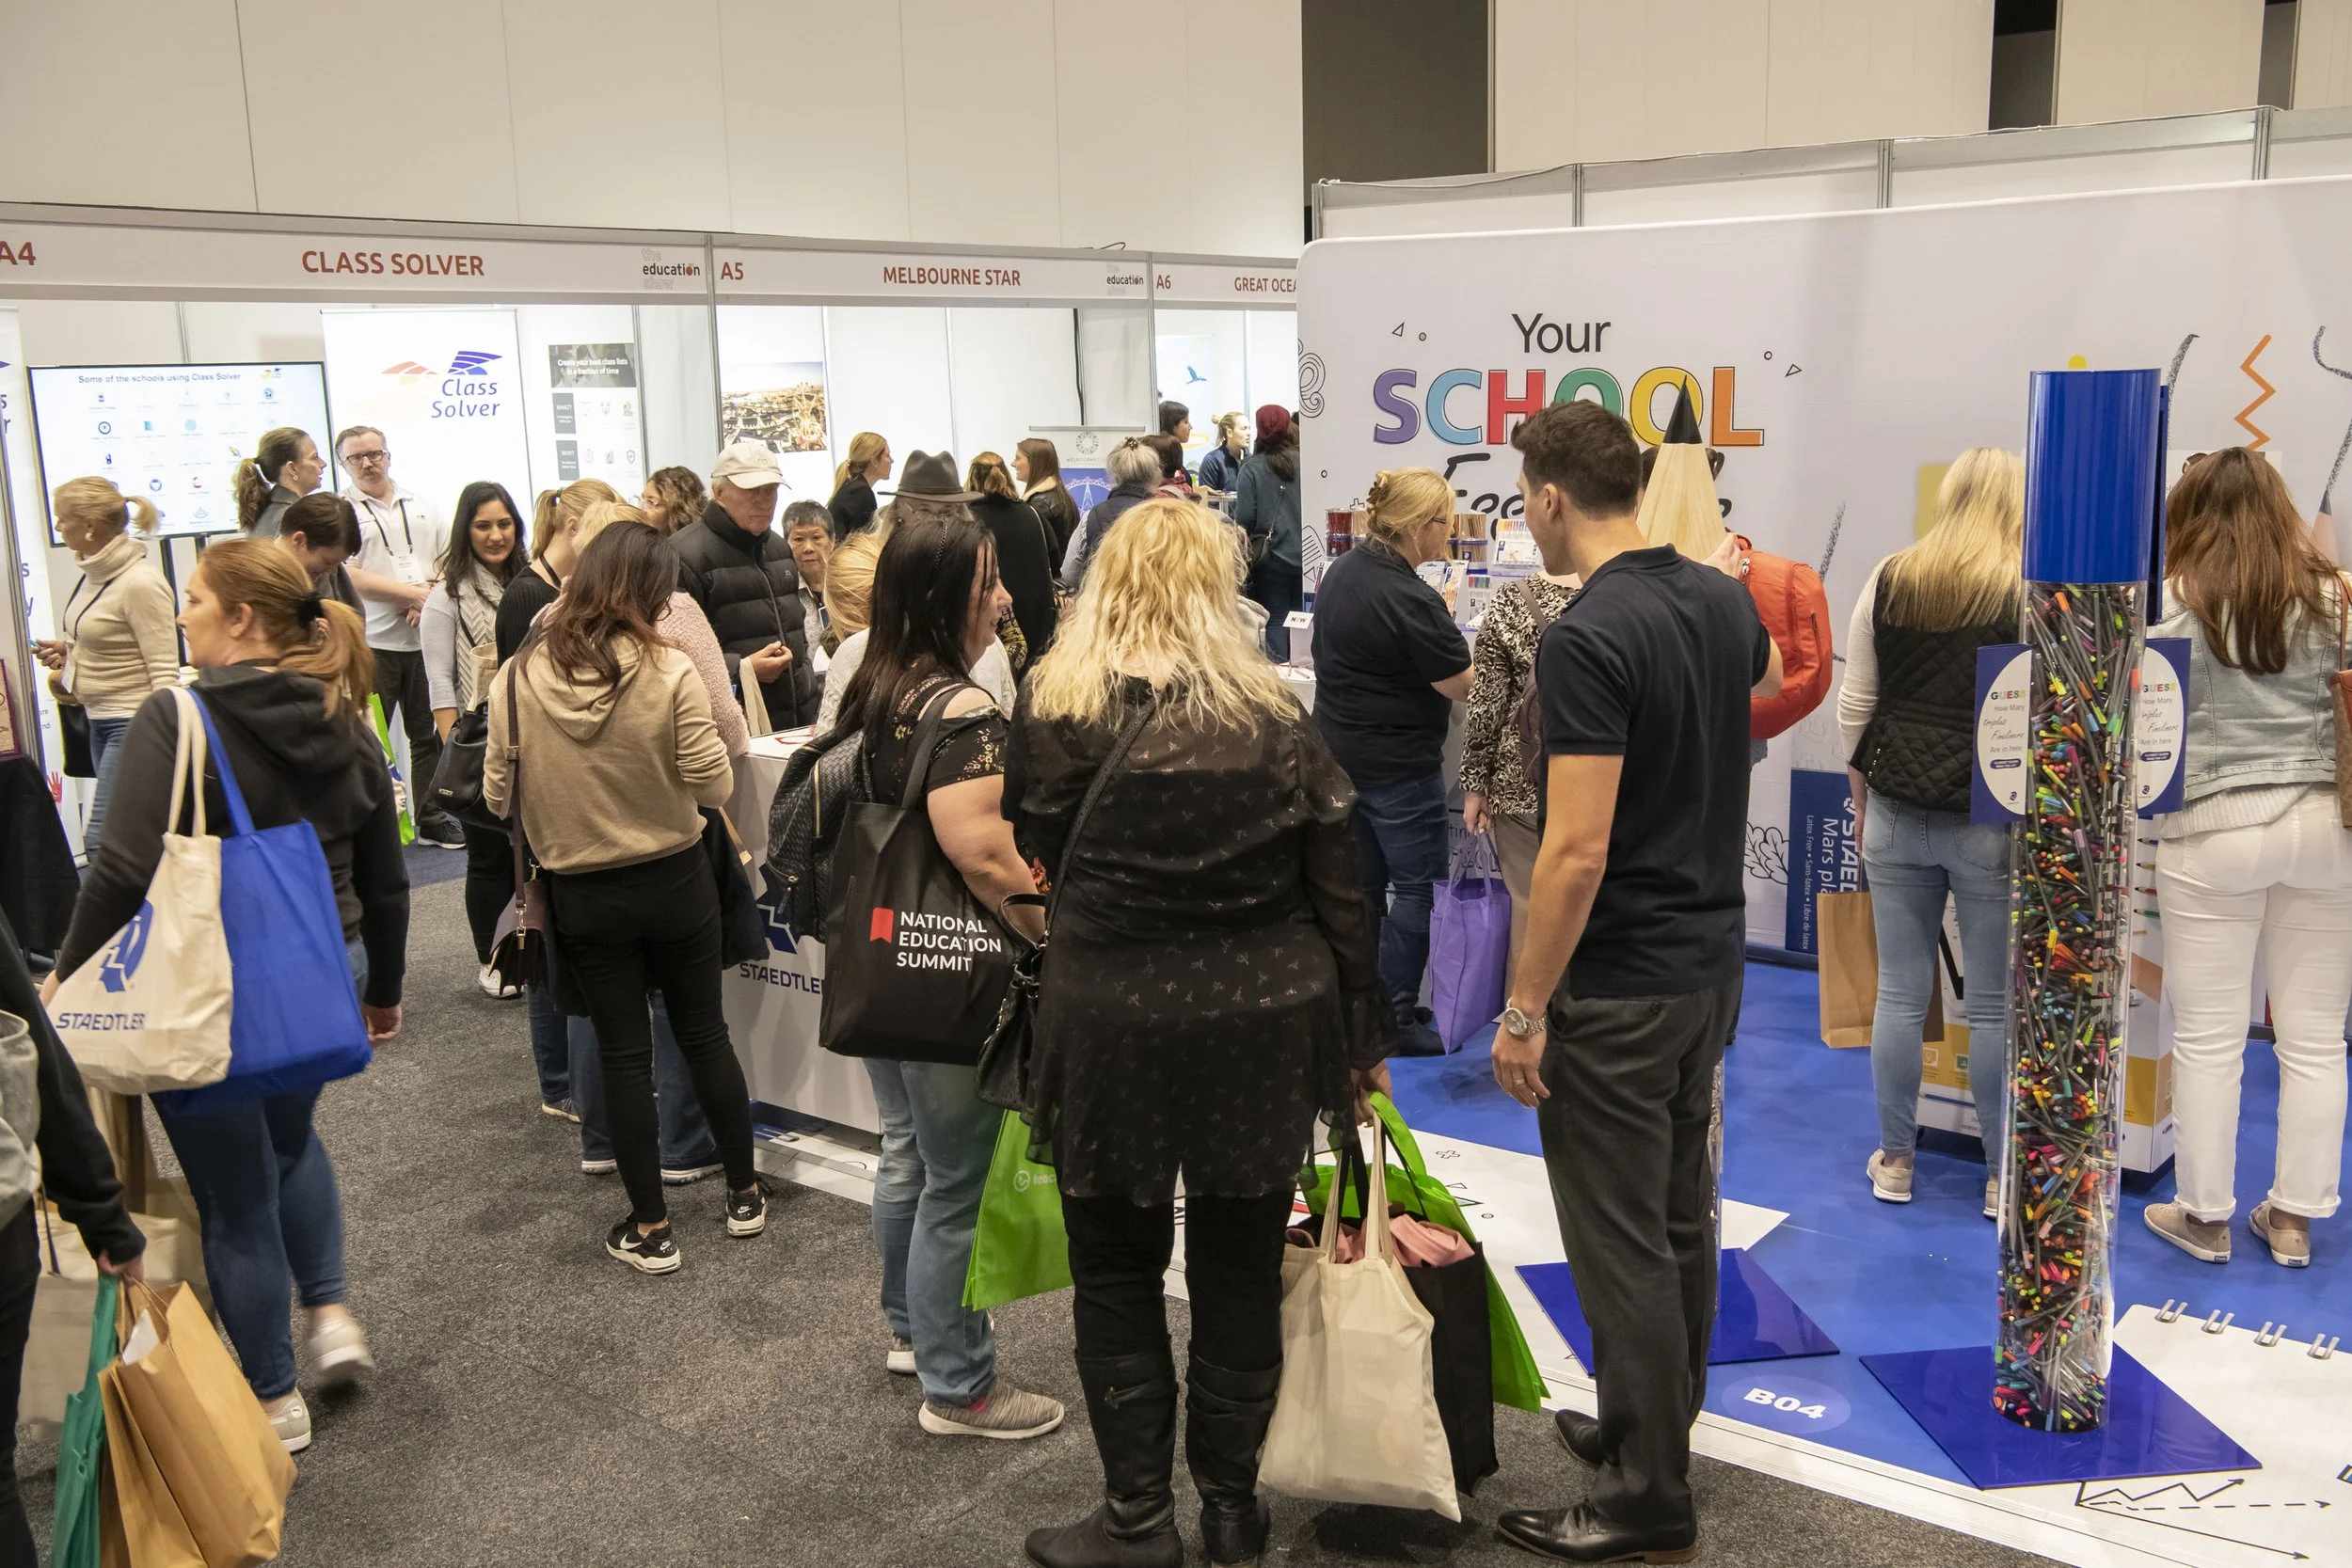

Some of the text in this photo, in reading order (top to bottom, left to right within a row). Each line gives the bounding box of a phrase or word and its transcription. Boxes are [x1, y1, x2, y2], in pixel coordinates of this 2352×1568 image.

[0, 241, 37, 265] A4
[301, 250, 485, 277] CLASS SOLVER
[643, 263, 701, 276] education
[721, 262, 744, 280] A5
[883, 266, 1021, 286] MELBOURNE STAR
[1106, 275, 1144, 285] education
[1156, 275, 1171, 290] A6
[1234, 277, 1269, 292] GREAT
[1511, 312, 1611, 354] Your
[78, 375, 103, 384] Some
[132, 374, 165, 383] schools
[167, 374, 189, 384] using
[216, 372, 241, 381] Solver
[441, 378, 498, 397] Class
[431, 400, 501, 419] Solver
[1373, 366, 1764, 447] SCHOOL
[1991, 690, 2026, 701] GUESS
[2142, 683, 2176, 693] GUESS
[2010, 705, 2025, 713] Many
[1821, 817, 1839, 864] Mars
[1804, 859, 1813, 896] Sans-latex
[1804, 903, 1812, 922] Libre
[900, 911, 988, 934] NATIONAL
[1804, 924, 1811, 932] de
[898, 931, 1002, 953] EDUCATION
[1802, 934, 1812, 950] latex
[897, 951, 972, 972] SUMMIT
[739, 962, 824, 995] STAEDTLE
[56, 1012, 147, 1031] STAEDTLER
[1743, 1387, 1827, 1419] B04
